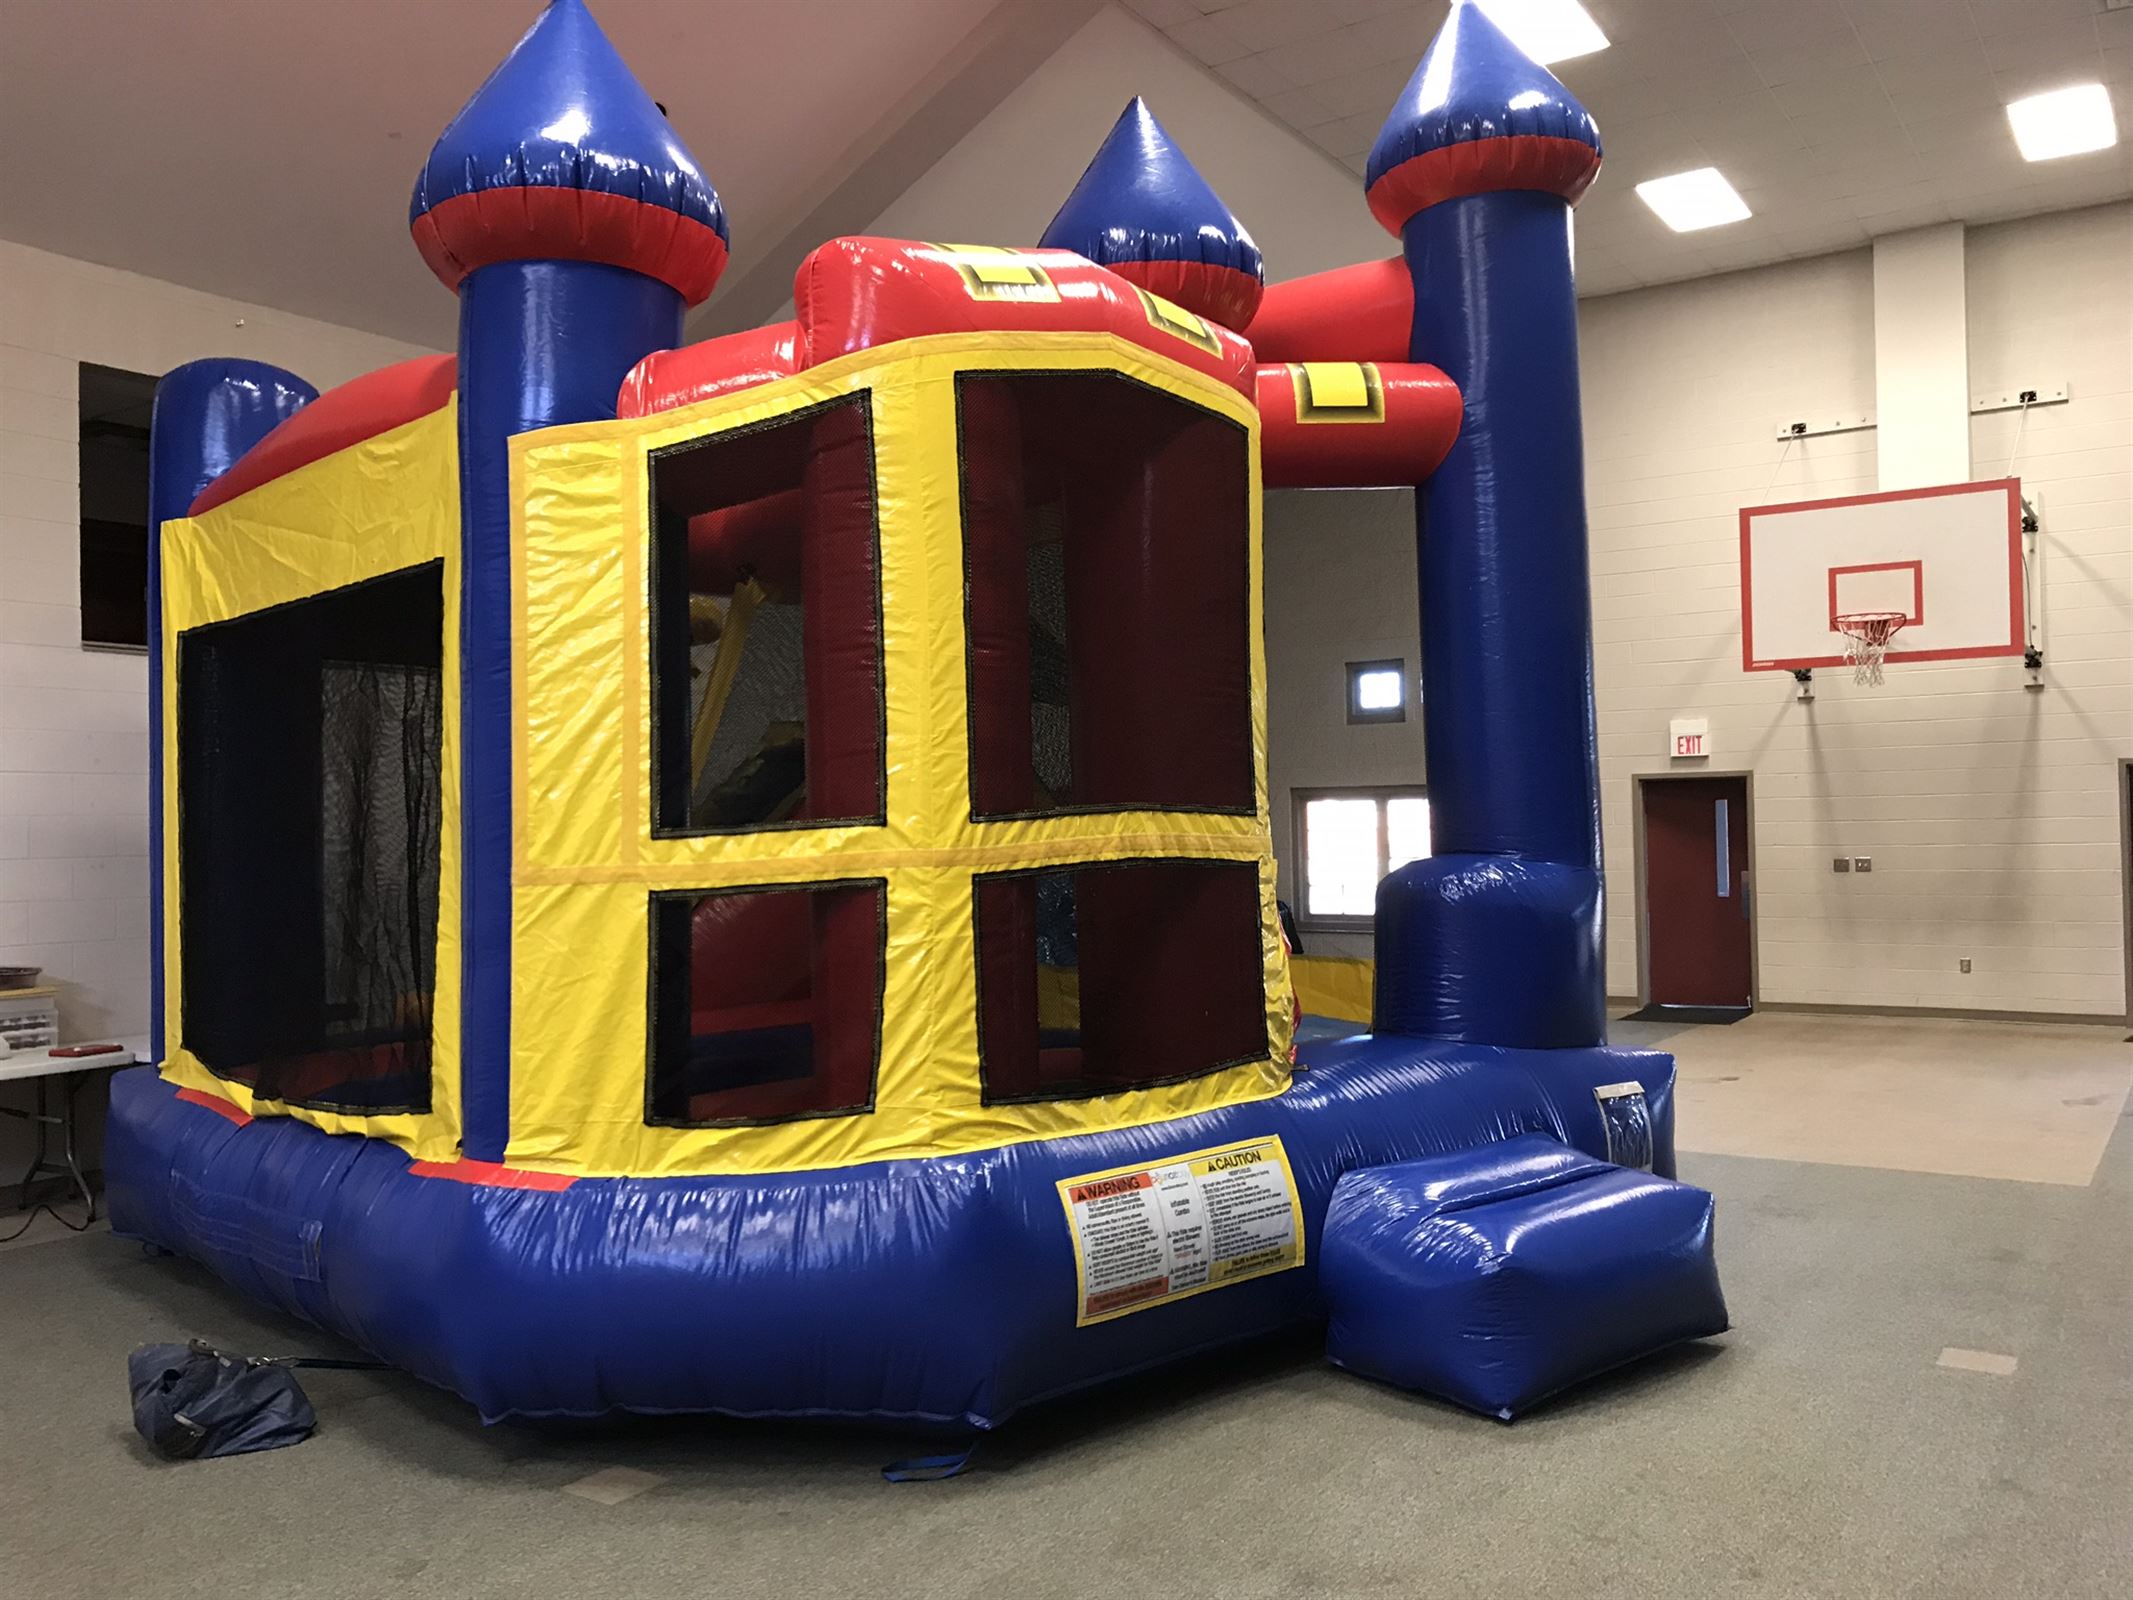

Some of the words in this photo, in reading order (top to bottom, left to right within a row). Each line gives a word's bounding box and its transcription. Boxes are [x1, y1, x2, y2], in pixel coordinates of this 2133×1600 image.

[1677, 735, 1702, 754] EXIT
[1215, 1150, 1262, 1170] CAUTION
[1085, 1176, 1141, 1199] WARNING
